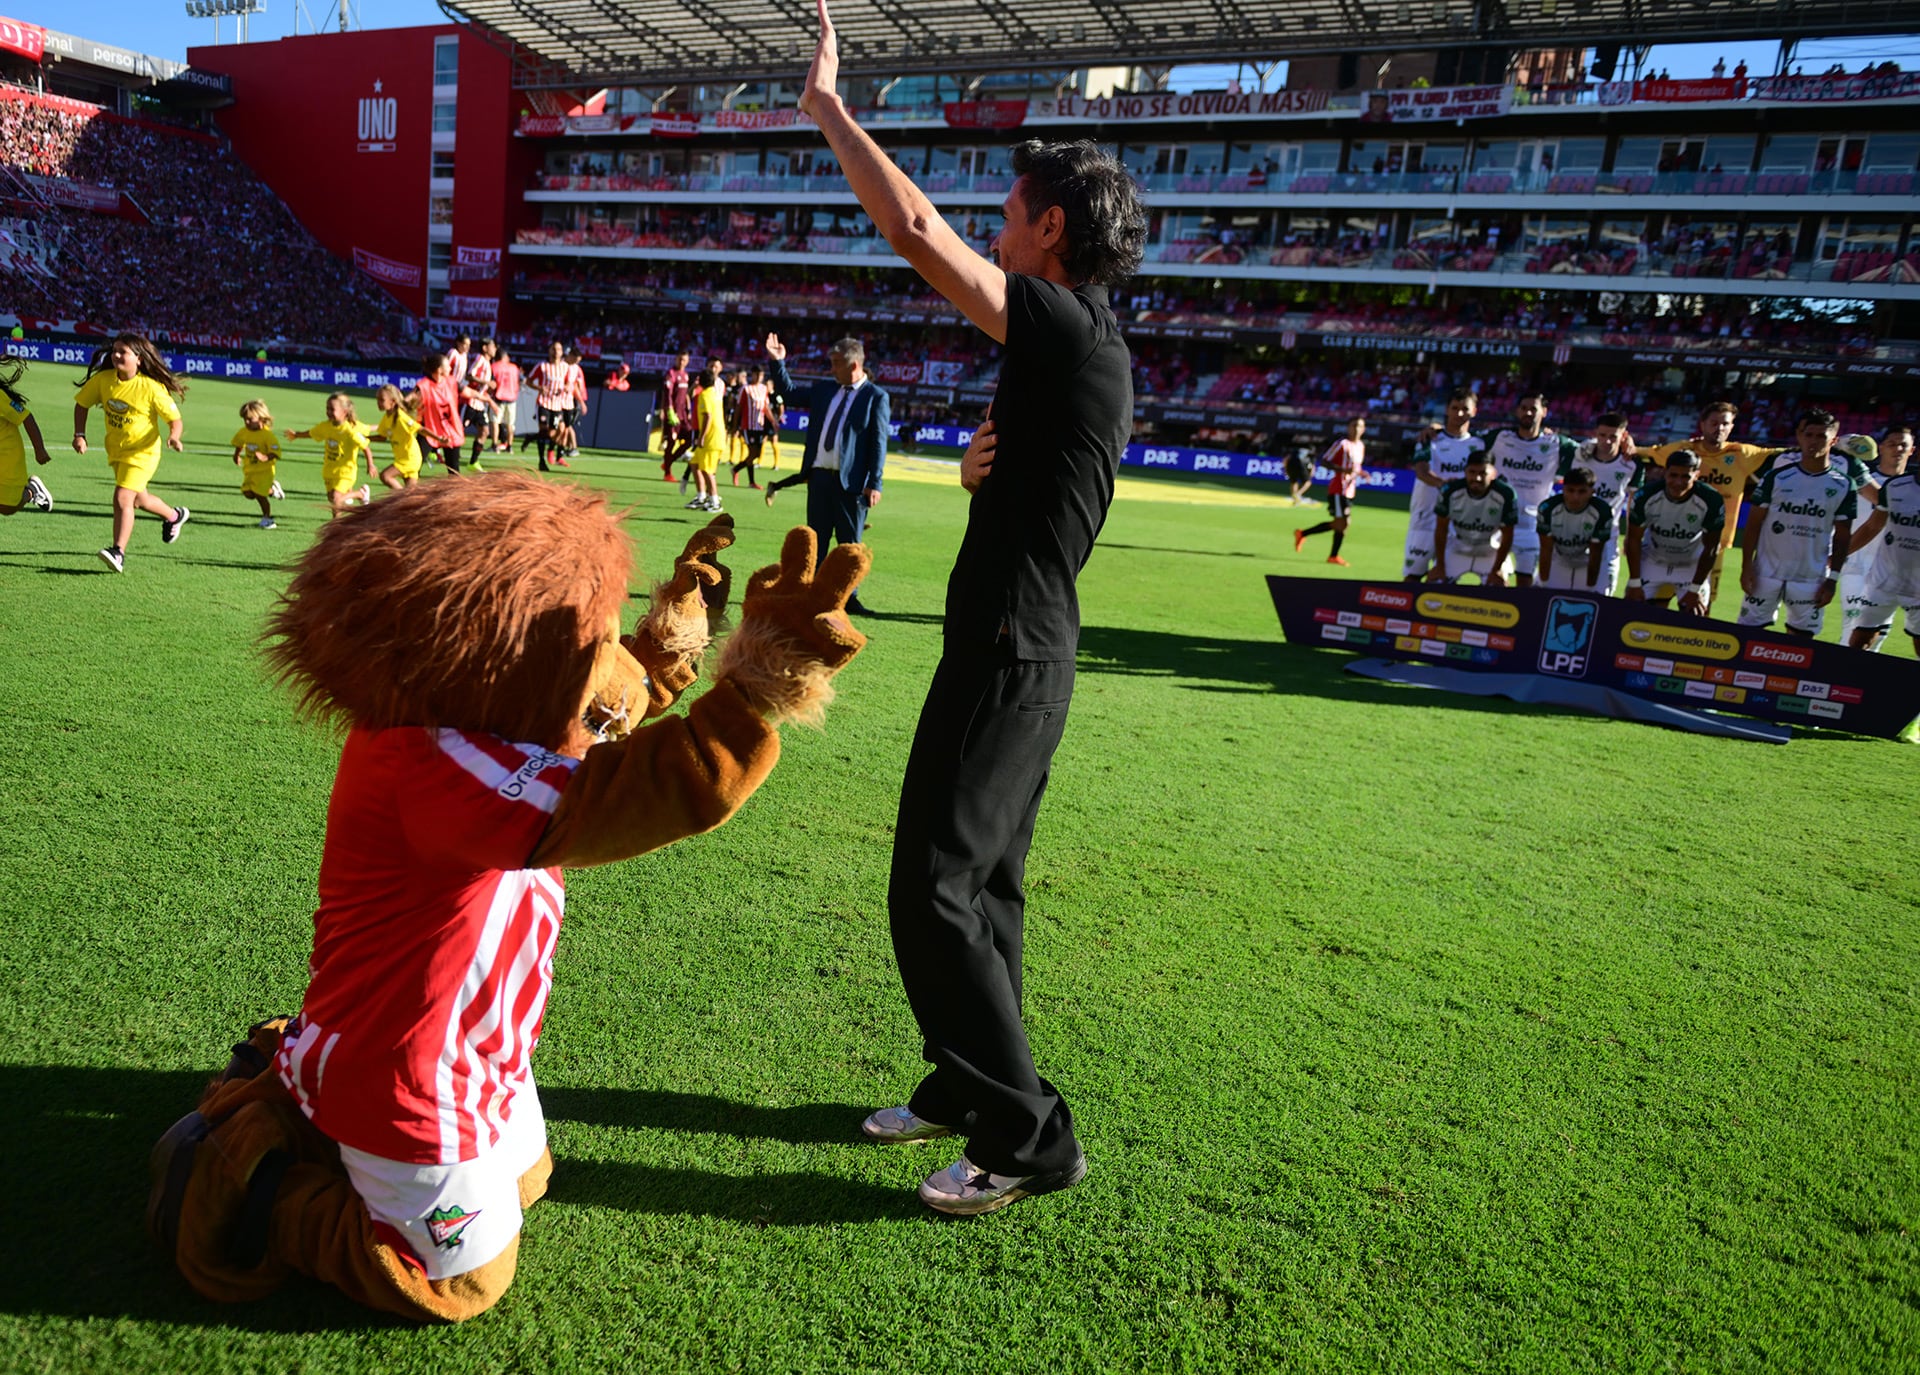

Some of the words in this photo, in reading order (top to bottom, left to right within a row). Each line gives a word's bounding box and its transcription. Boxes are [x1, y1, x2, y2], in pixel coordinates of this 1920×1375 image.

[1057, 99, 1075, 116] EL
[1084, 99, 1110, 116] 7-0
[1116, 98, 1143, 117] NO
[1149, 97, 1169, 116] SE
[1178, 93, 1250, 115] OLVIDA
[357, 97, 398, 141] UNO
[1322, 335, 1352, 348] CLUB
[1355, 336, 1438, 352] ESTUDIANTES
[1441, 342, 1457, 353] DE
[1461, 342, 1478, 354] LA
[1481, 343, 1521, 356] PLATA
[53, 347, 86, 363] pax
[186, 358, 214, 374] pax
[226, 361, 253, 377] pax
[264, 364, 289, 380] pax
[300, 367, 325, 383] pax
[334, 370, 358, 385] pax
[367, 373, 390, 388] pax
[400, 376, 418, 390] pa
[915, 426, 946, 443] pax
[1143, 448, 1180, 466] pax
[1193, 453, 1231, 471] pax
[1503, 457, 1544, 472] Naldo
[1246, 458, 1289, 480] pax
[1441, 460, 1467, 473] Nal
[1698, 472, 1732, 486] aldo
[1779, 501, 1826, 518] Naldo
[1890, 511, 1920, 529] Nal
[1651, 523, 1698, 540] Naldo
[1364, 591, 1408, 607] Betano
[1445, 603, 1489, 617] mercado
[1490, 607, 1513, 620] libre
[1654, 632, 1704, 648] mercado
[1705, 640, 1731, 652] libre
[1541, 651, 1585, 673] LPF
[1750, 644, 1806, 664] Betano
[1801, 683, 1825, 695] pax
